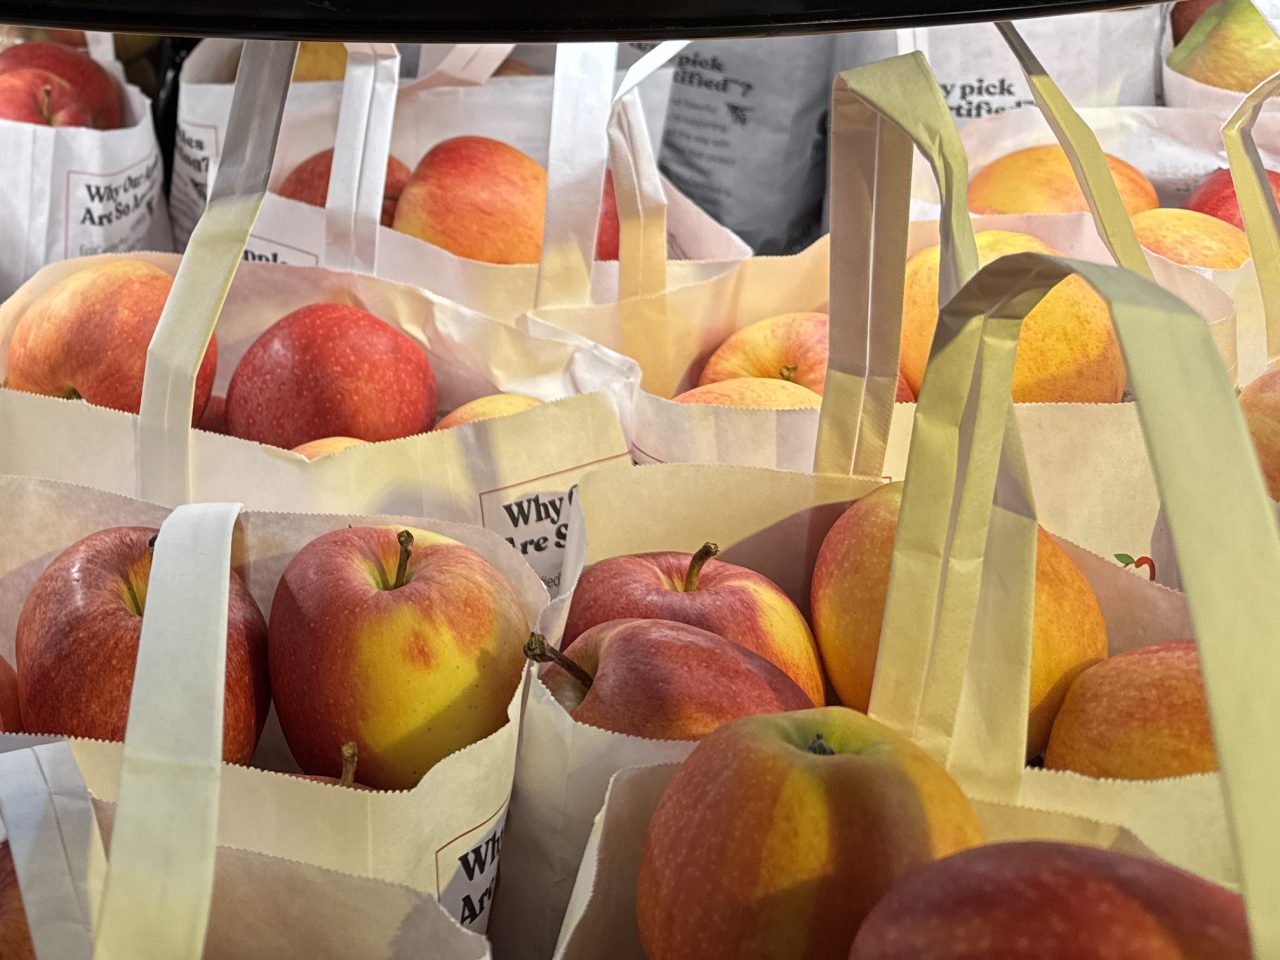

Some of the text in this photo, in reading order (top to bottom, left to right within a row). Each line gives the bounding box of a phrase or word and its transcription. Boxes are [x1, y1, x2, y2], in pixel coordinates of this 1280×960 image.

[959, 77, 1016, 101] pick
[84, 183, 121, 203] Why
[80, 201, 131, 227] Are So
[502, 493, 564, 528] Why
[458, 829, 504, 882] Wh
